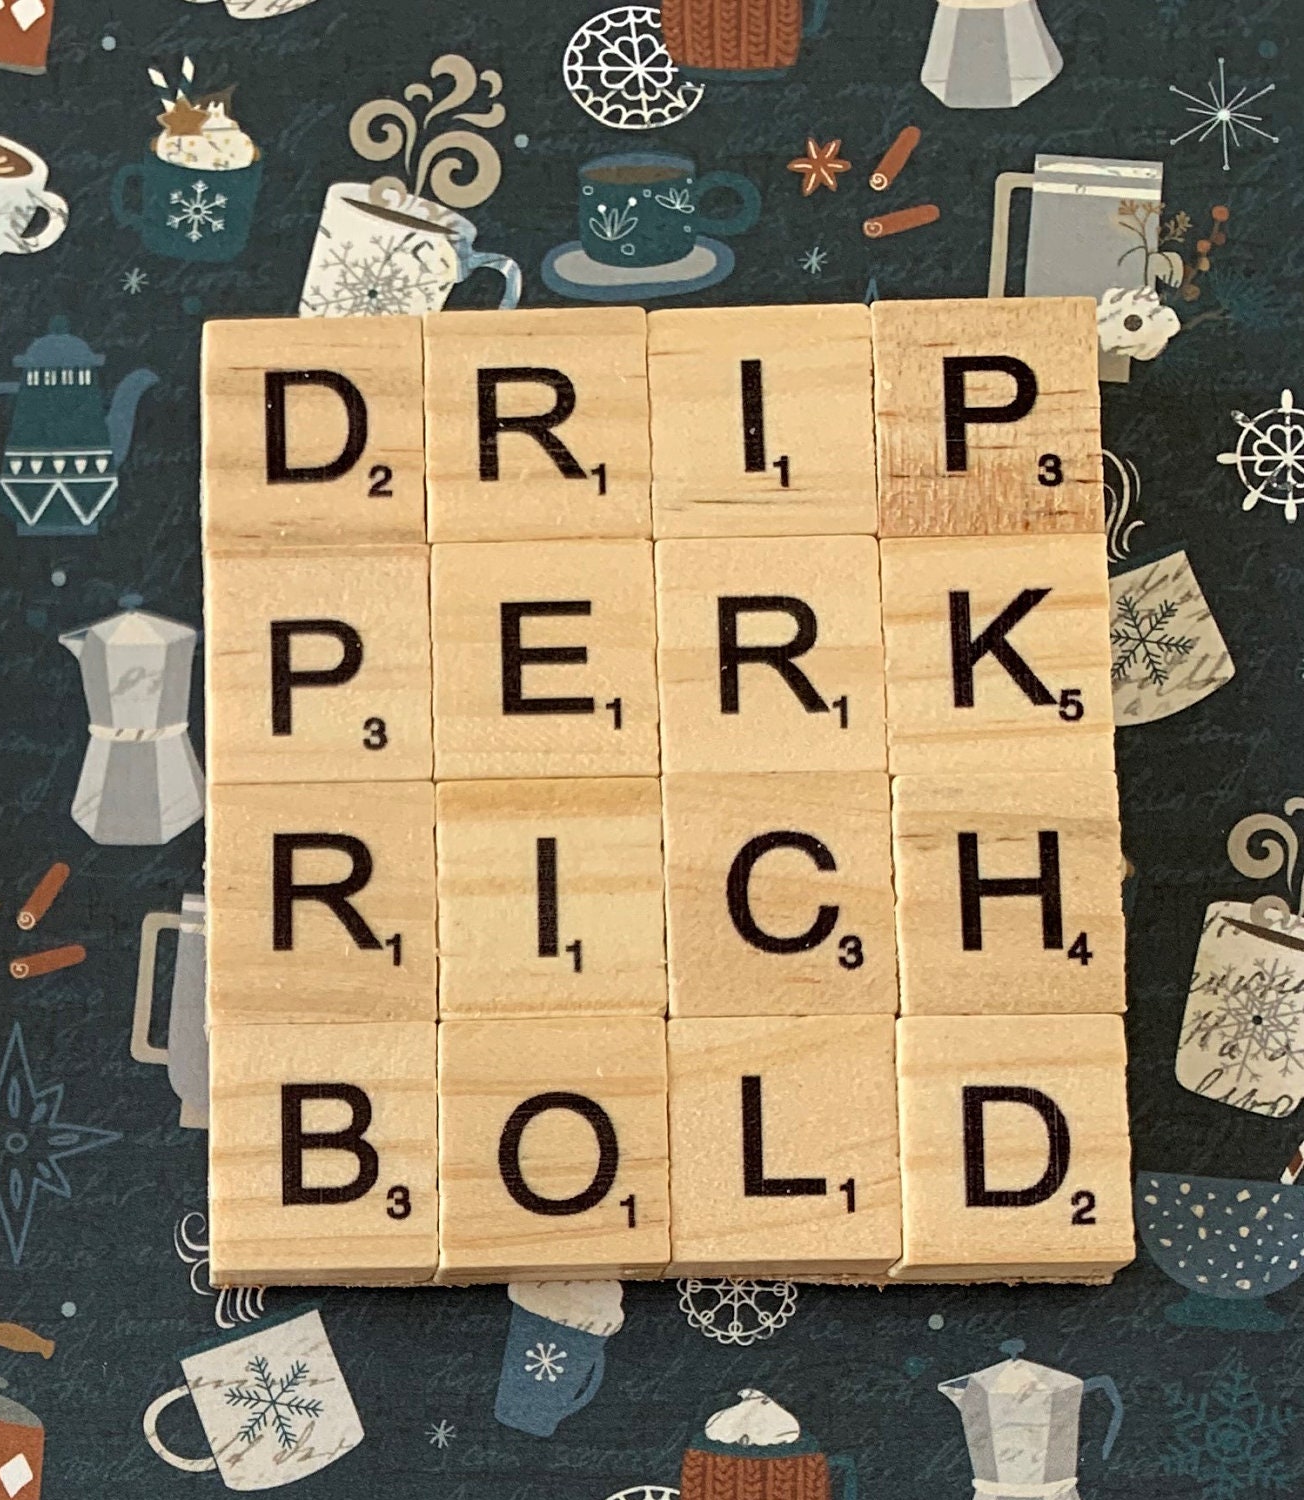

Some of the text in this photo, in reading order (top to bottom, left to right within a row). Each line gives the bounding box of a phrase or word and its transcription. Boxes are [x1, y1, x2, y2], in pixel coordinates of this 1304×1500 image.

[367, 452, 1065, 499] 2 1 1 3
[362, 687, 1086, 752] 3 1 1 5
[384, 930, 1095, 974] 1 1 3 4
[385, 1176, 1097, 1230] 3 1 1 2
